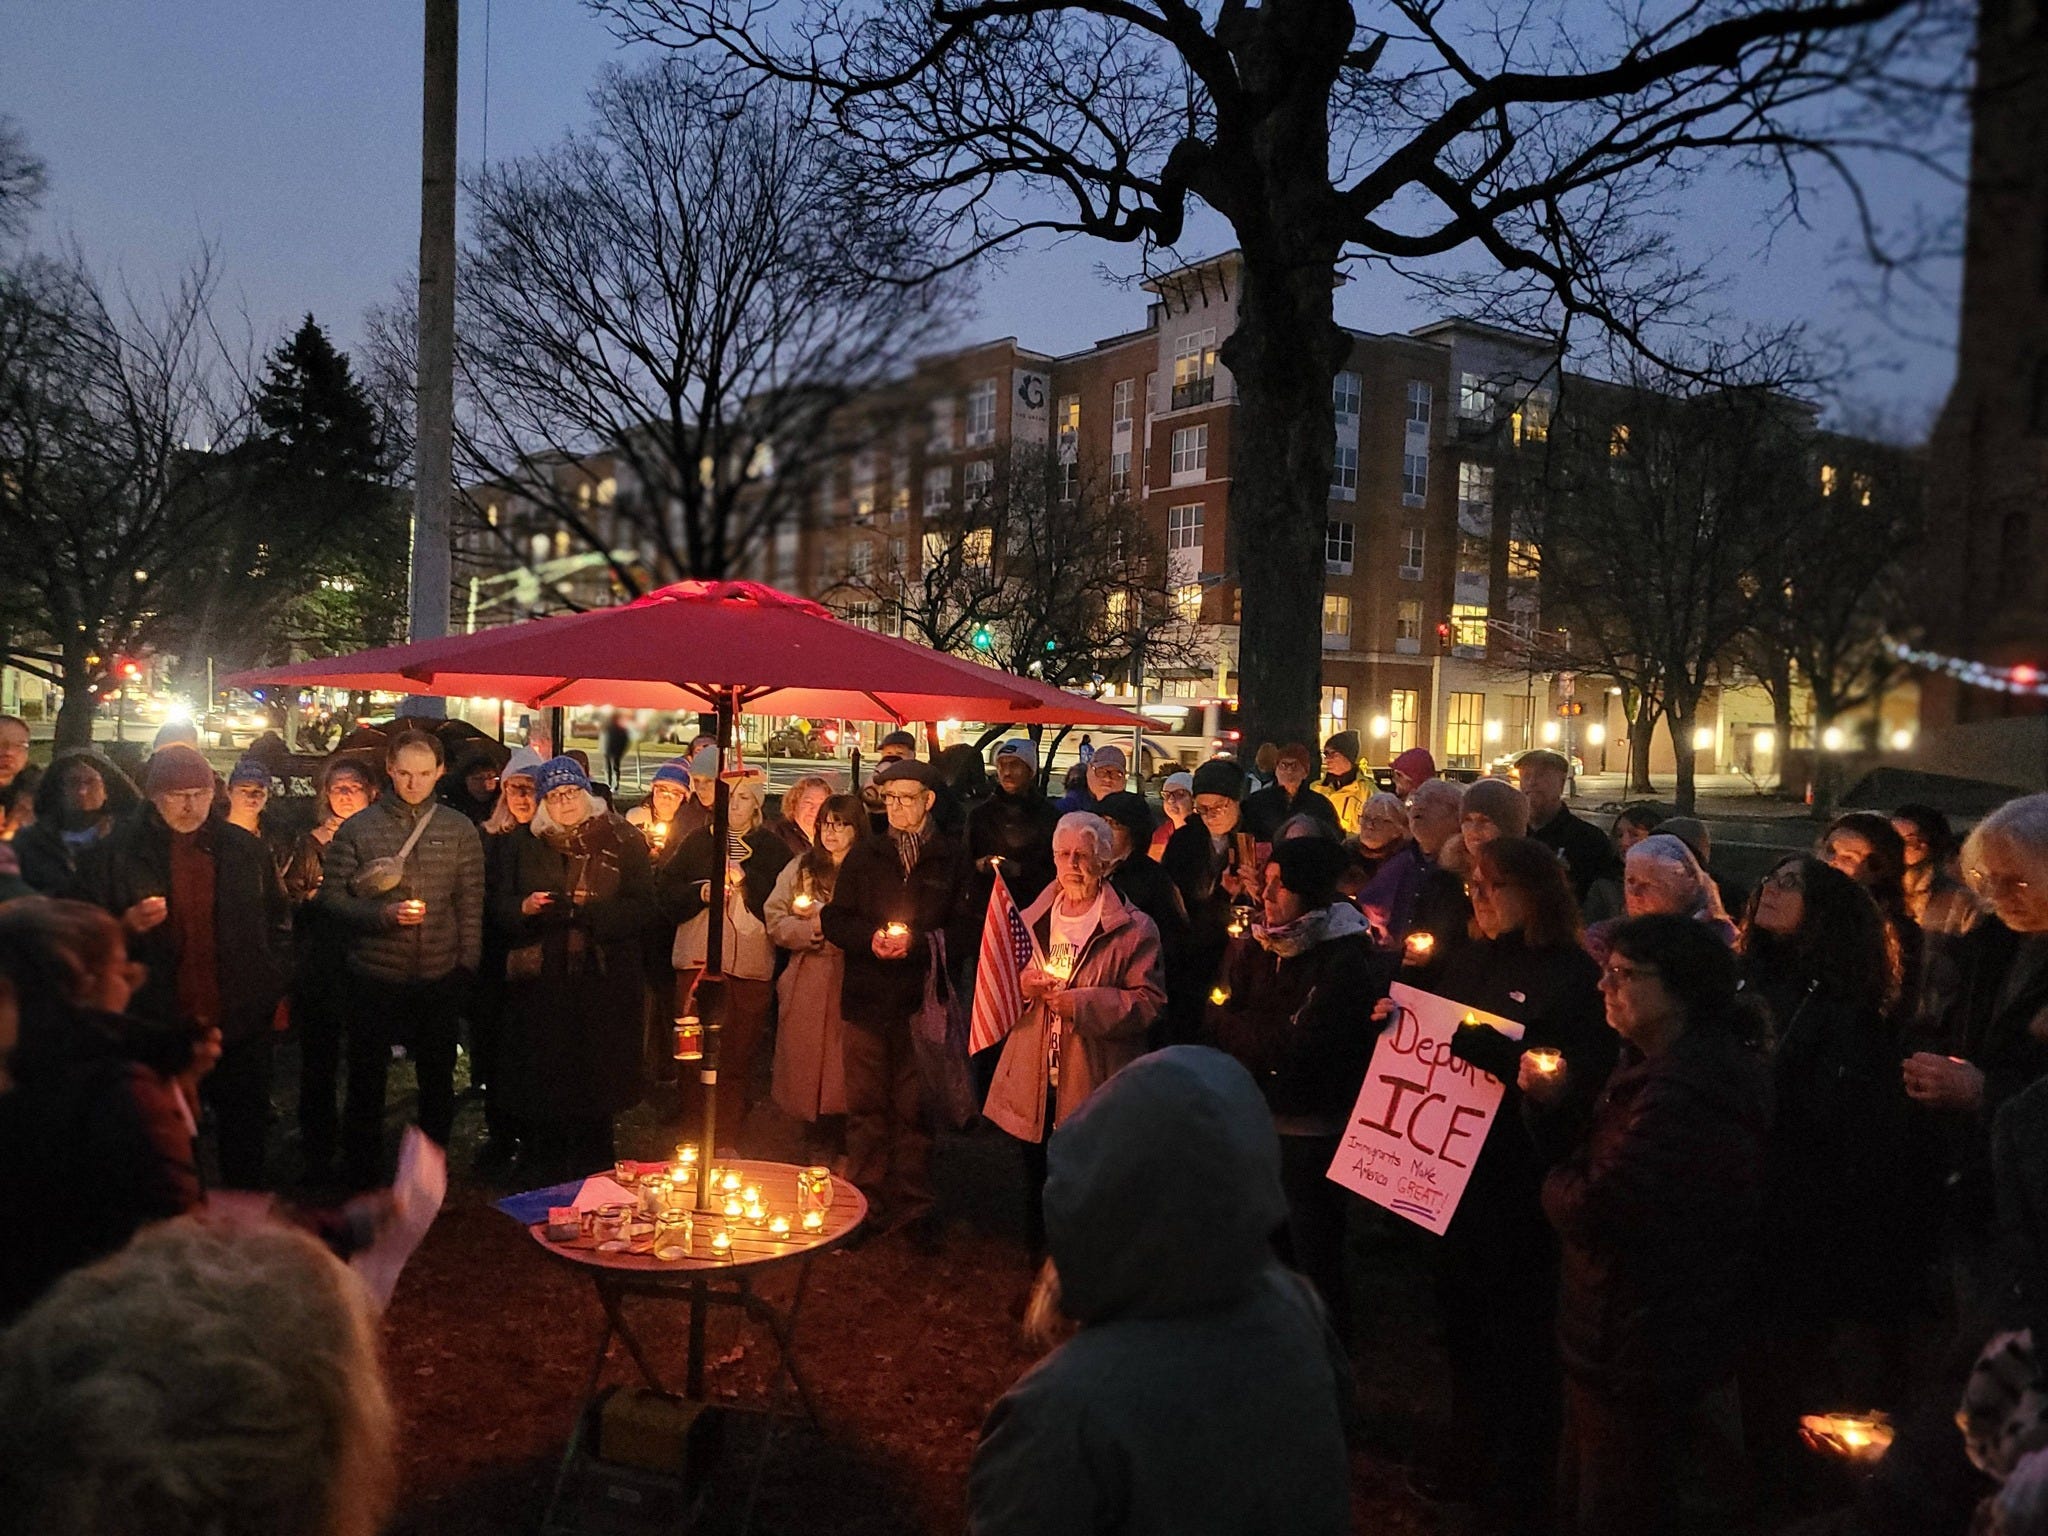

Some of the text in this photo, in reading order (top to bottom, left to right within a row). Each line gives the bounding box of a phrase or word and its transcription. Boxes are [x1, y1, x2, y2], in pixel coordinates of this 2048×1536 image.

[1389, 1006, 1496, 1092] Depor
[1358, 1074, 1485, 1168] ICE
[1397, 1176, 1449, 1214] GREAT!
[1410, 1159, 1436, 1185] Make
